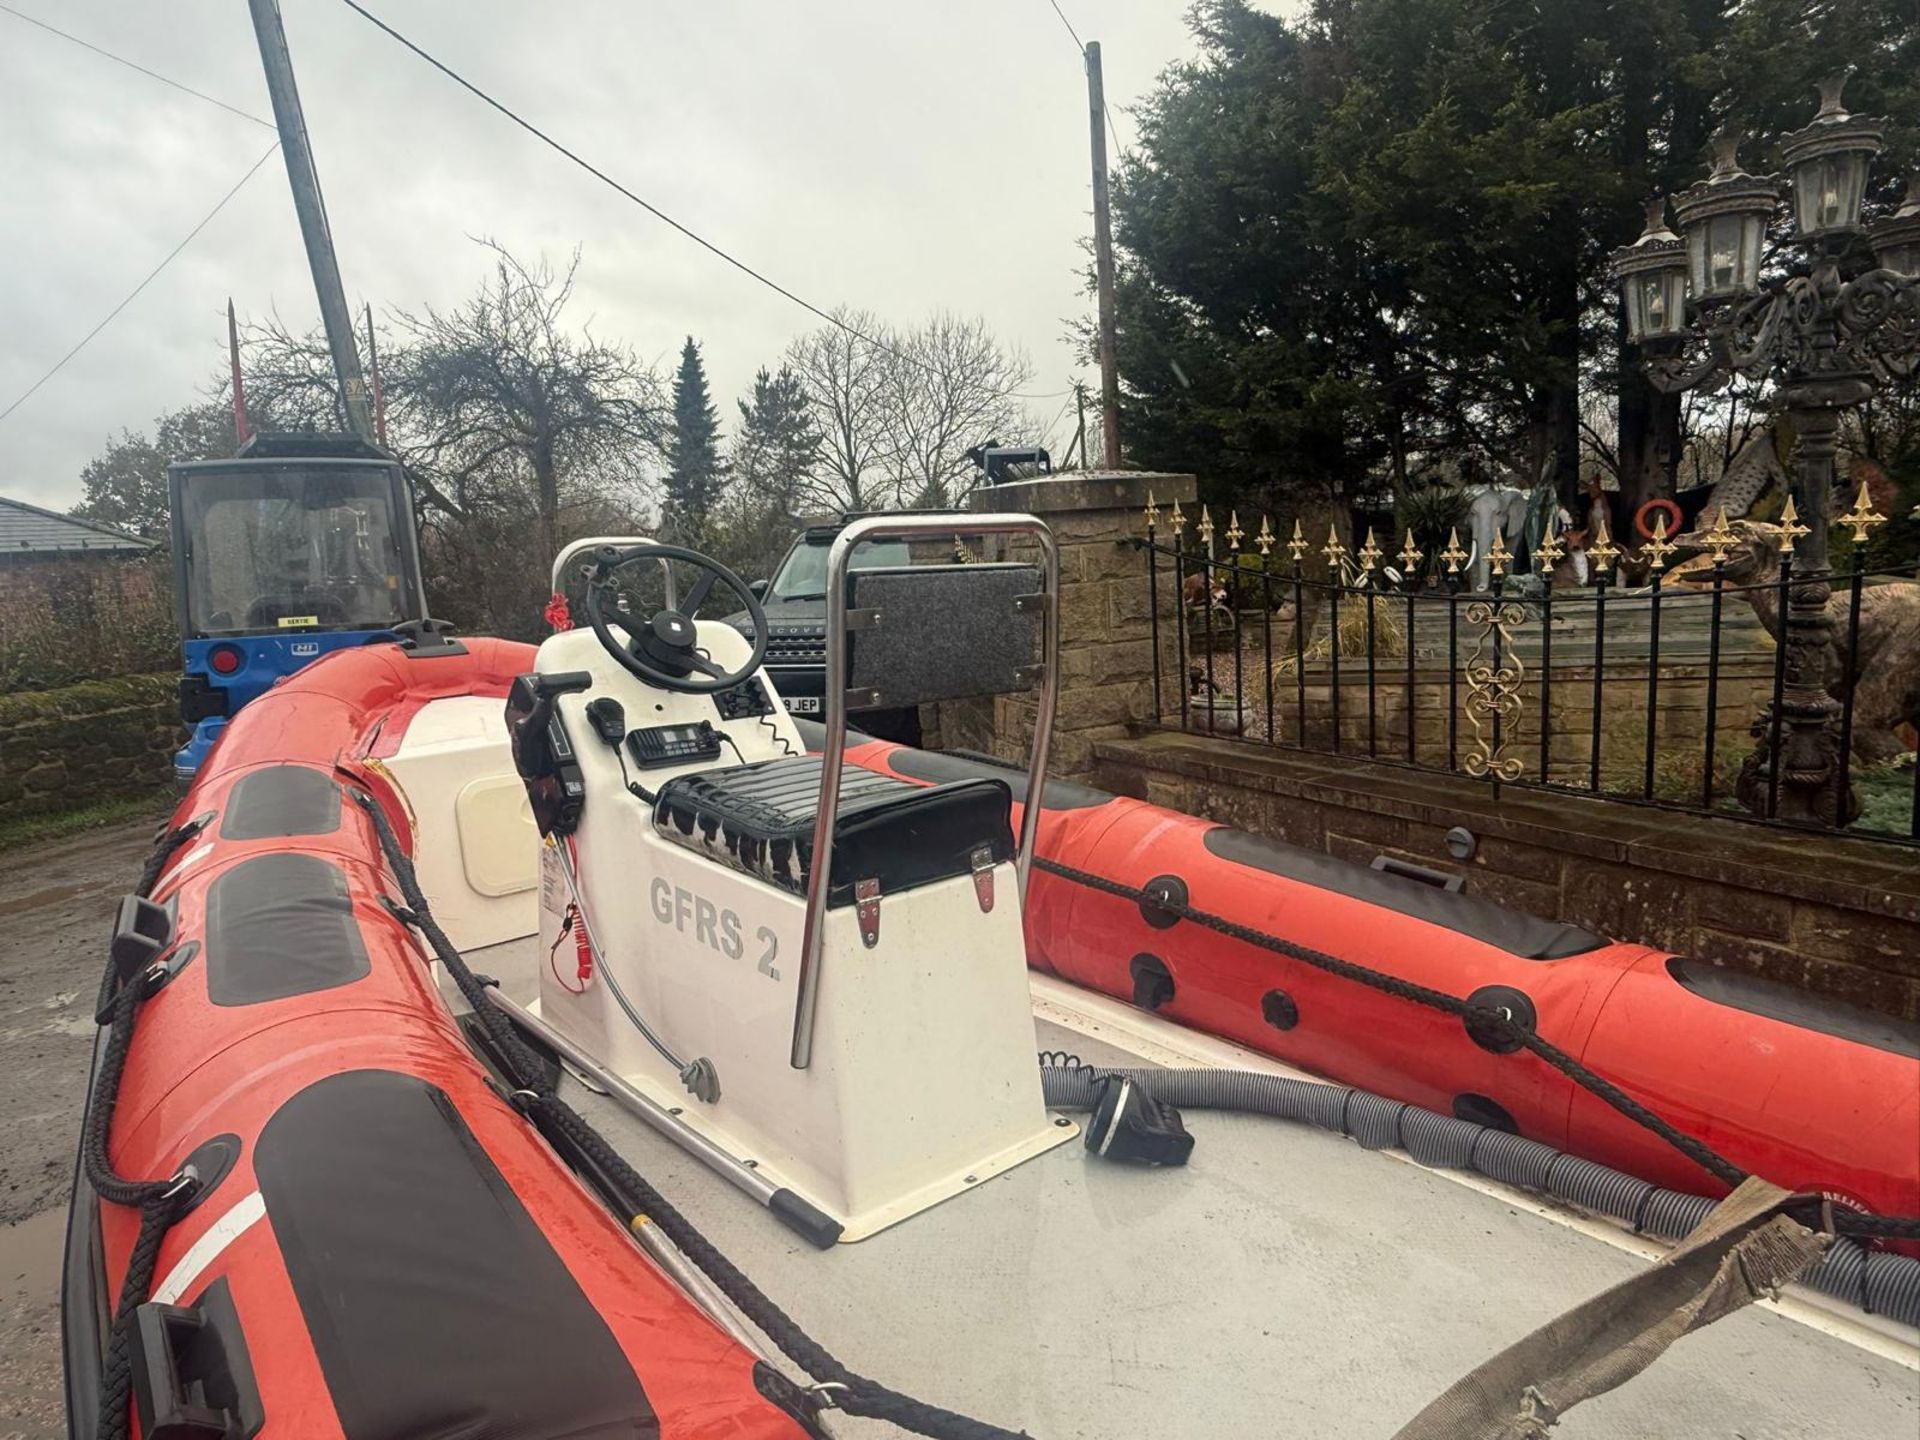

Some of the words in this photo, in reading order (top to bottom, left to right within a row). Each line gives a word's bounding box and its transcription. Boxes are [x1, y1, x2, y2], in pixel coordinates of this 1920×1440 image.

[794, 699, 817, 711] JEP
[650, 876, 744, 961] GFRS
[756, 925, 781, 982] 2
